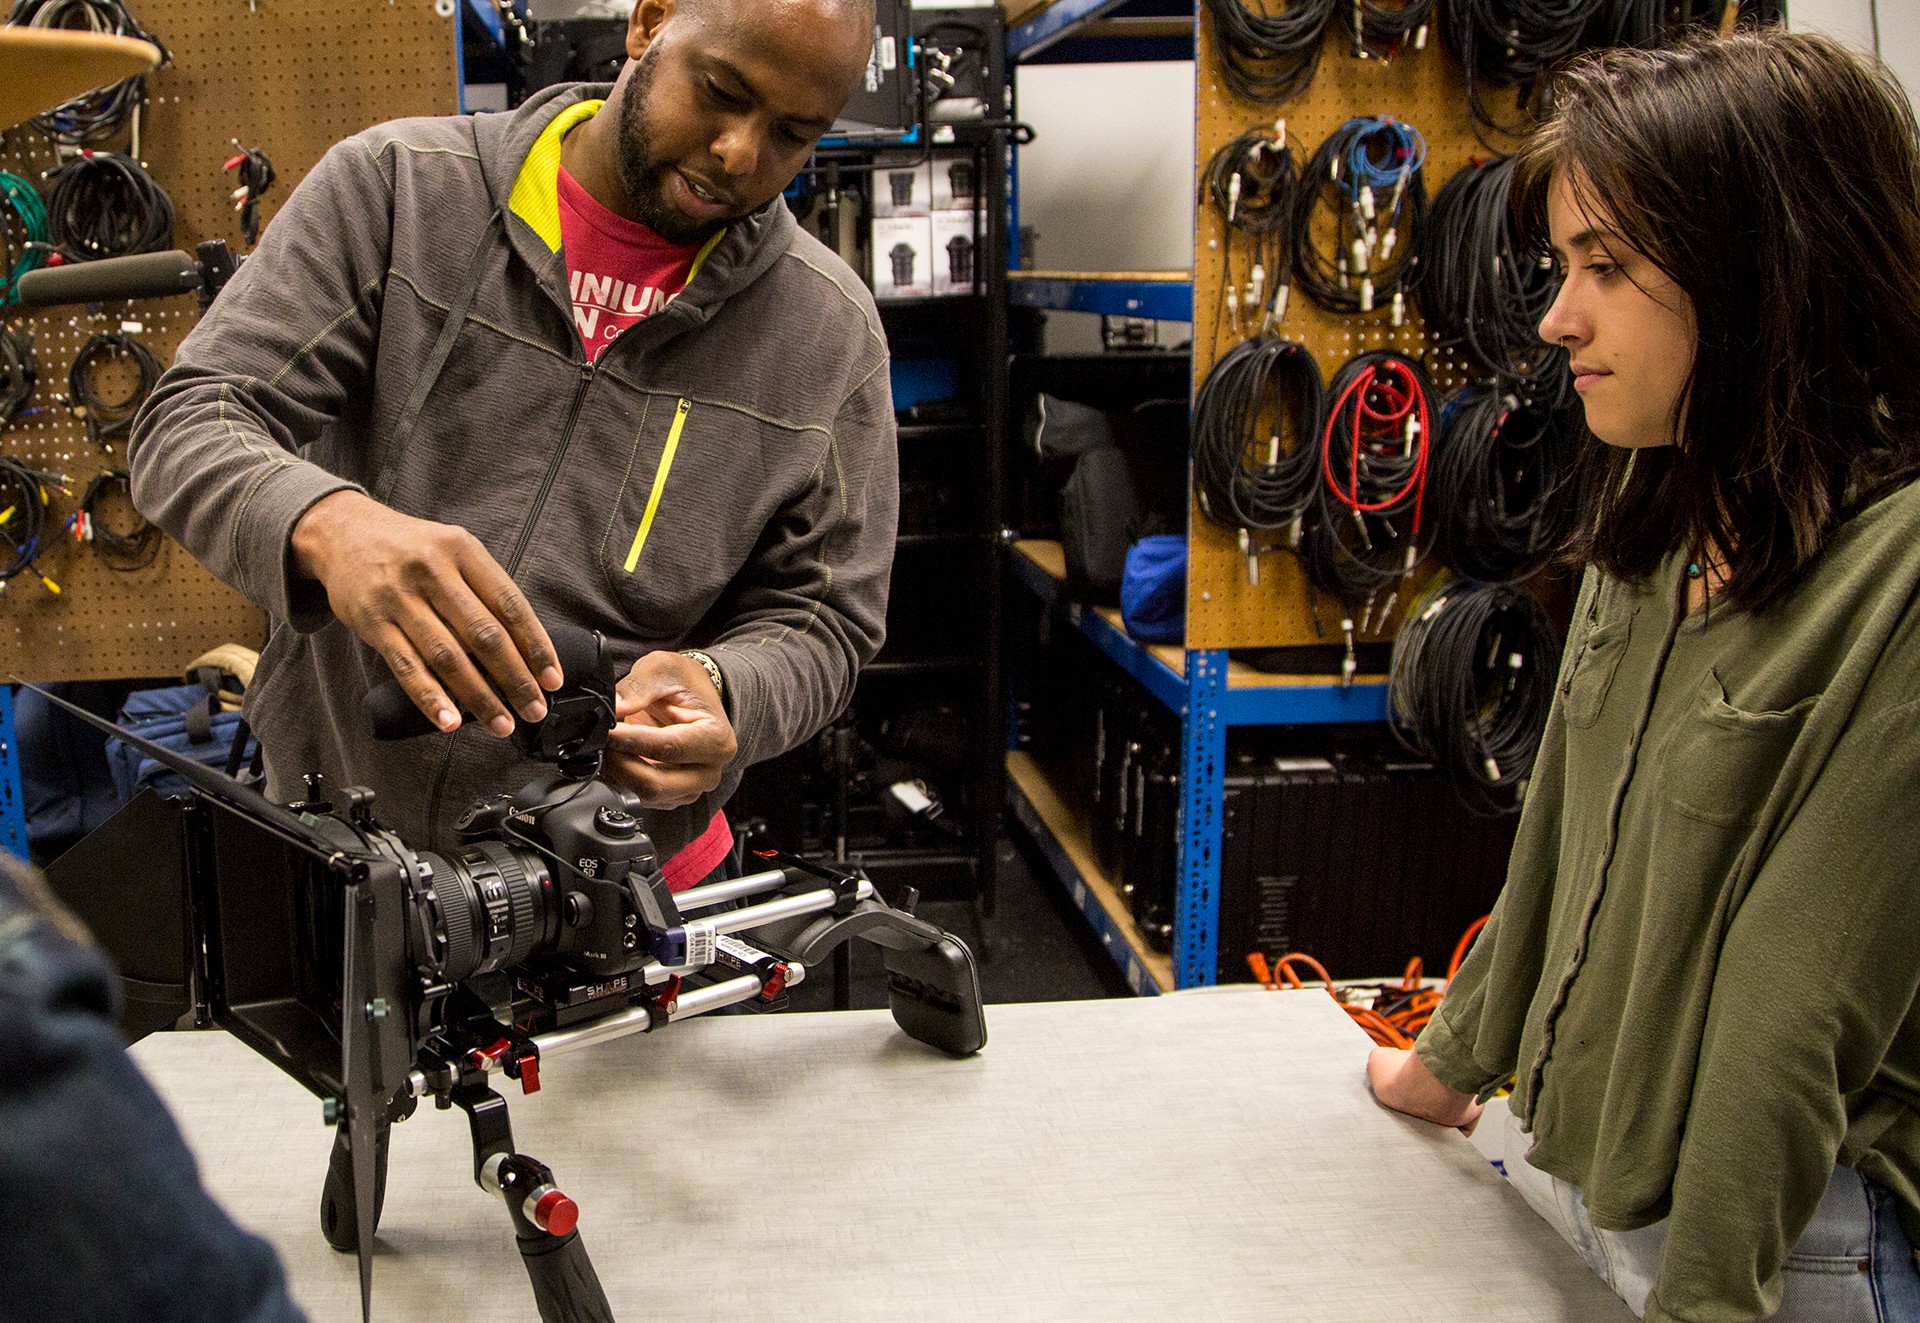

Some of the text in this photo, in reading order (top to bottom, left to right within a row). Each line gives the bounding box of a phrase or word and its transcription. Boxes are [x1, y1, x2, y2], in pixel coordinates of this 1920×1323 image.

[579, 857, 598, 869] EOS
[583, 867, 596, 878] 5D
[586, 976, 628, 995] SHAPE
